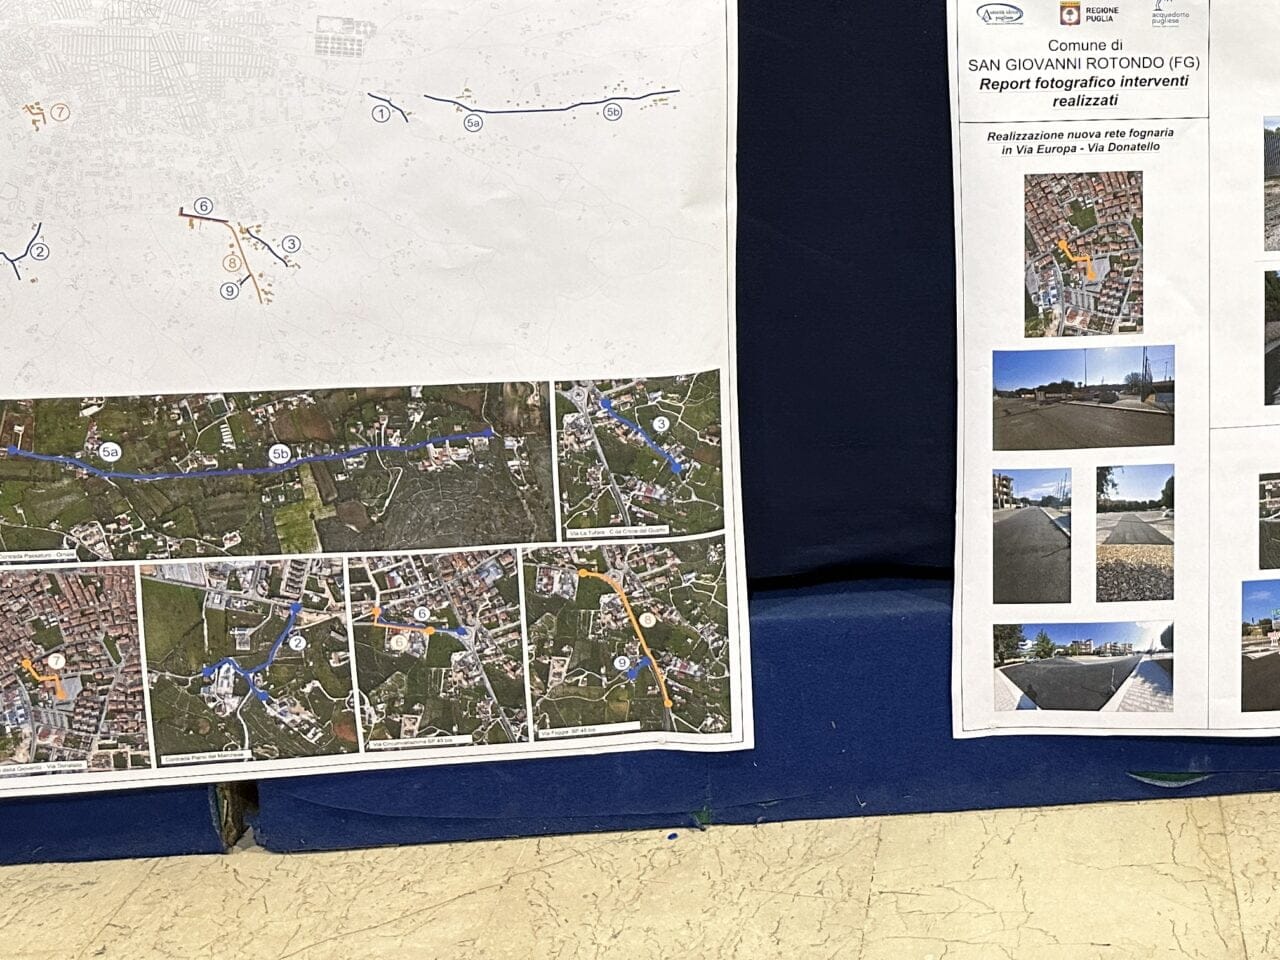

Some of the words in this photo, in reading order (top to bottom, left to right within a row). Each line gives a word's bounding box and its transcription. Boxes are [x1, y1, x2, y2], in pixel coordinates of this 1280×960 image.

[1048, 40, 1106, 52] Comune
[1111, 39, 1123, 51] di
[968, 59, 1000, 71] SAN
[1006, 58, 1082, 70] GIOVANNI
[1086, 57, 1164, 70] ROTONDO
[1169, 56, 1200, 71] (FG)
[979, 78, 1030, 92] Report
[1034, 76, 1116, 92] fotografico
[1120, 74, 1190, 88] interventi
[1052, 94, 1118, 107] realizzati
[607, 106, 620, 117] 5b
[467, 118, 480, 128] 5a
[988, 130, 1064, 142] Realizzazione
[1067, 132, 1101, 140] nuova
[1104, 130, 1126, 138] rete
[1128, 128, 1174, 141] fognaria
[1002, 145, 1012, 155] in
[1016, 144, 1034, 154] Via
[1037, 144, 1076, 156] Europa
[1088, 142, 1104, 153] Via
[1108, 142, 1160, 152] Donatello
[658, 418, 665, 429] 3
[102, 447, 118, 457] 5a
[273, 448, 288, 459] 5b
[418, 608, 426, 620] 6
[293, 638, 302, 648] 2
[618, 658, 626, 668] 9
